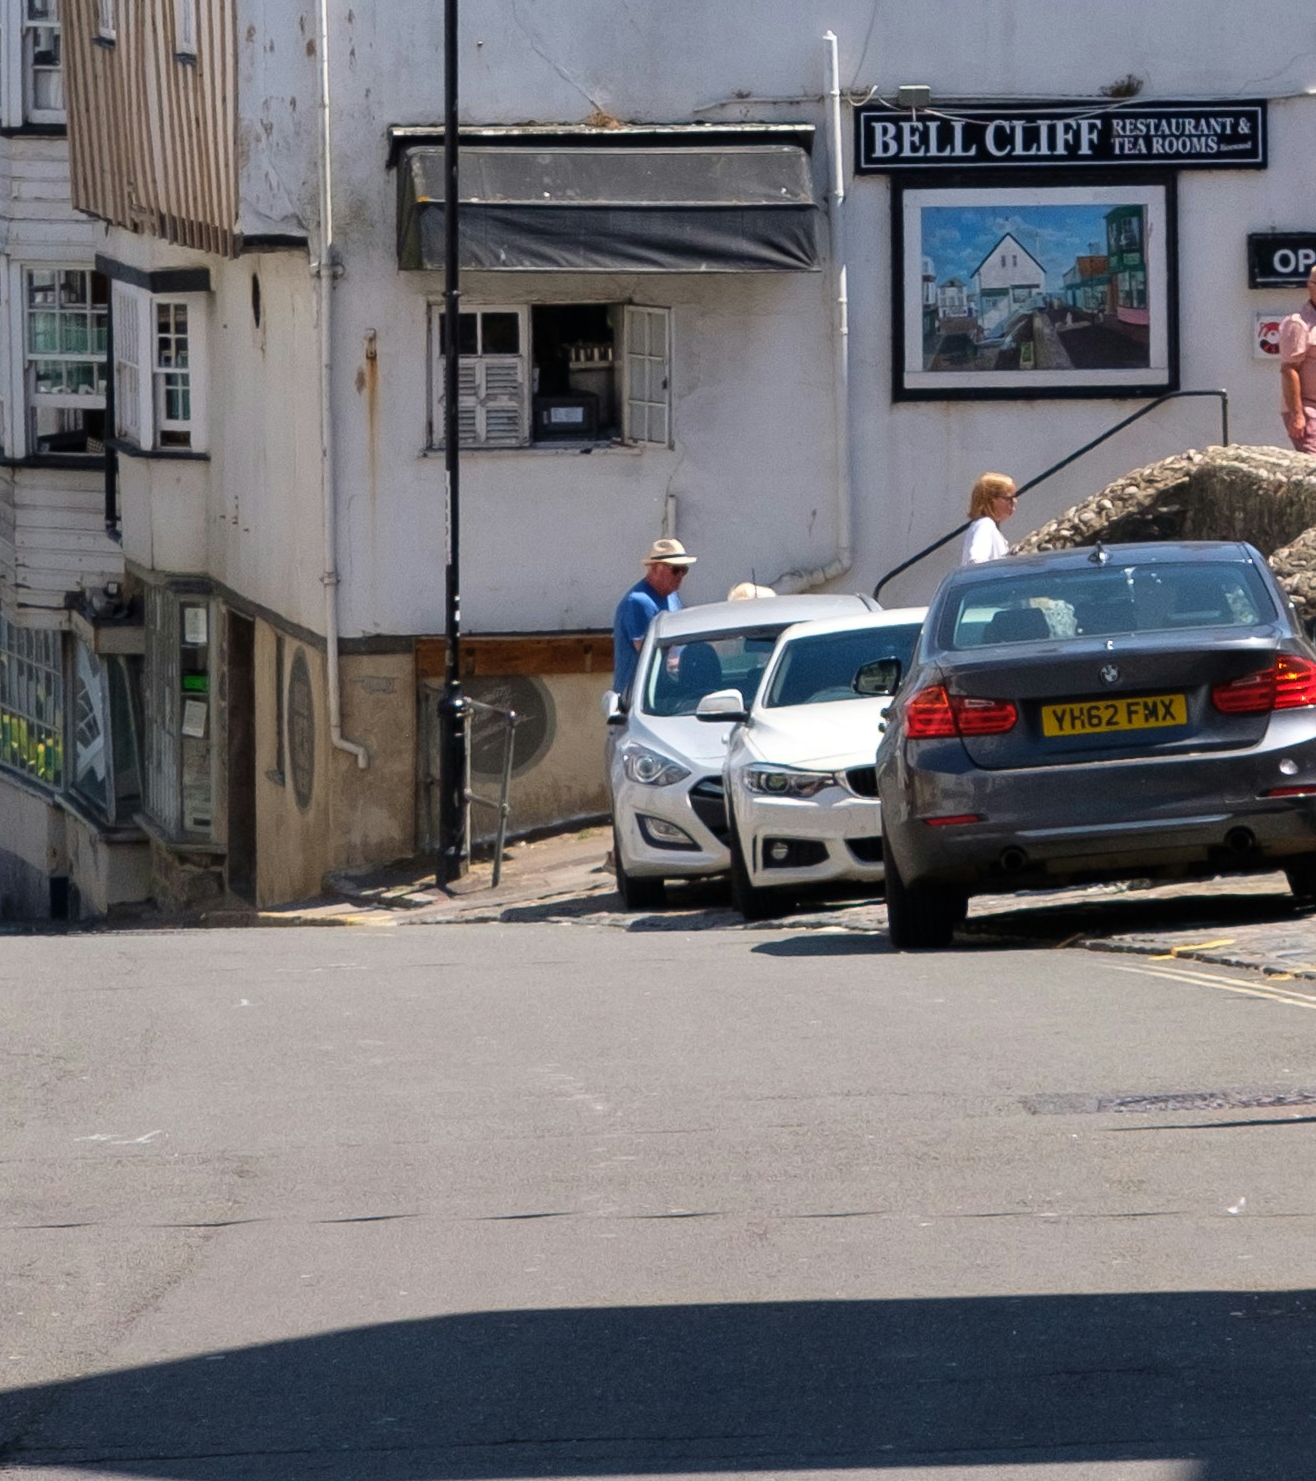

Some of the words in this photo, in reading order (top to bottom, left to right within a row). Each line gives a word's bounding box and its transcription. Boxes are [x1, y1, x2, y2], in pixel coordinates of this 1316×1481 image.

[871, 120, 976, 158] BELL
[984, 119, 1102, 157] CLIFF
[1111, 117, 1234, 136] RESTAURANT
[1237, 116, 1252, 135] &
[1111, 137, 1147, 155] TEA
[1151, 135, 1218, 154] ROOMS
[1051, 703, 1120, 732] YH62
[1125, 698, 1177, 725] FMX
